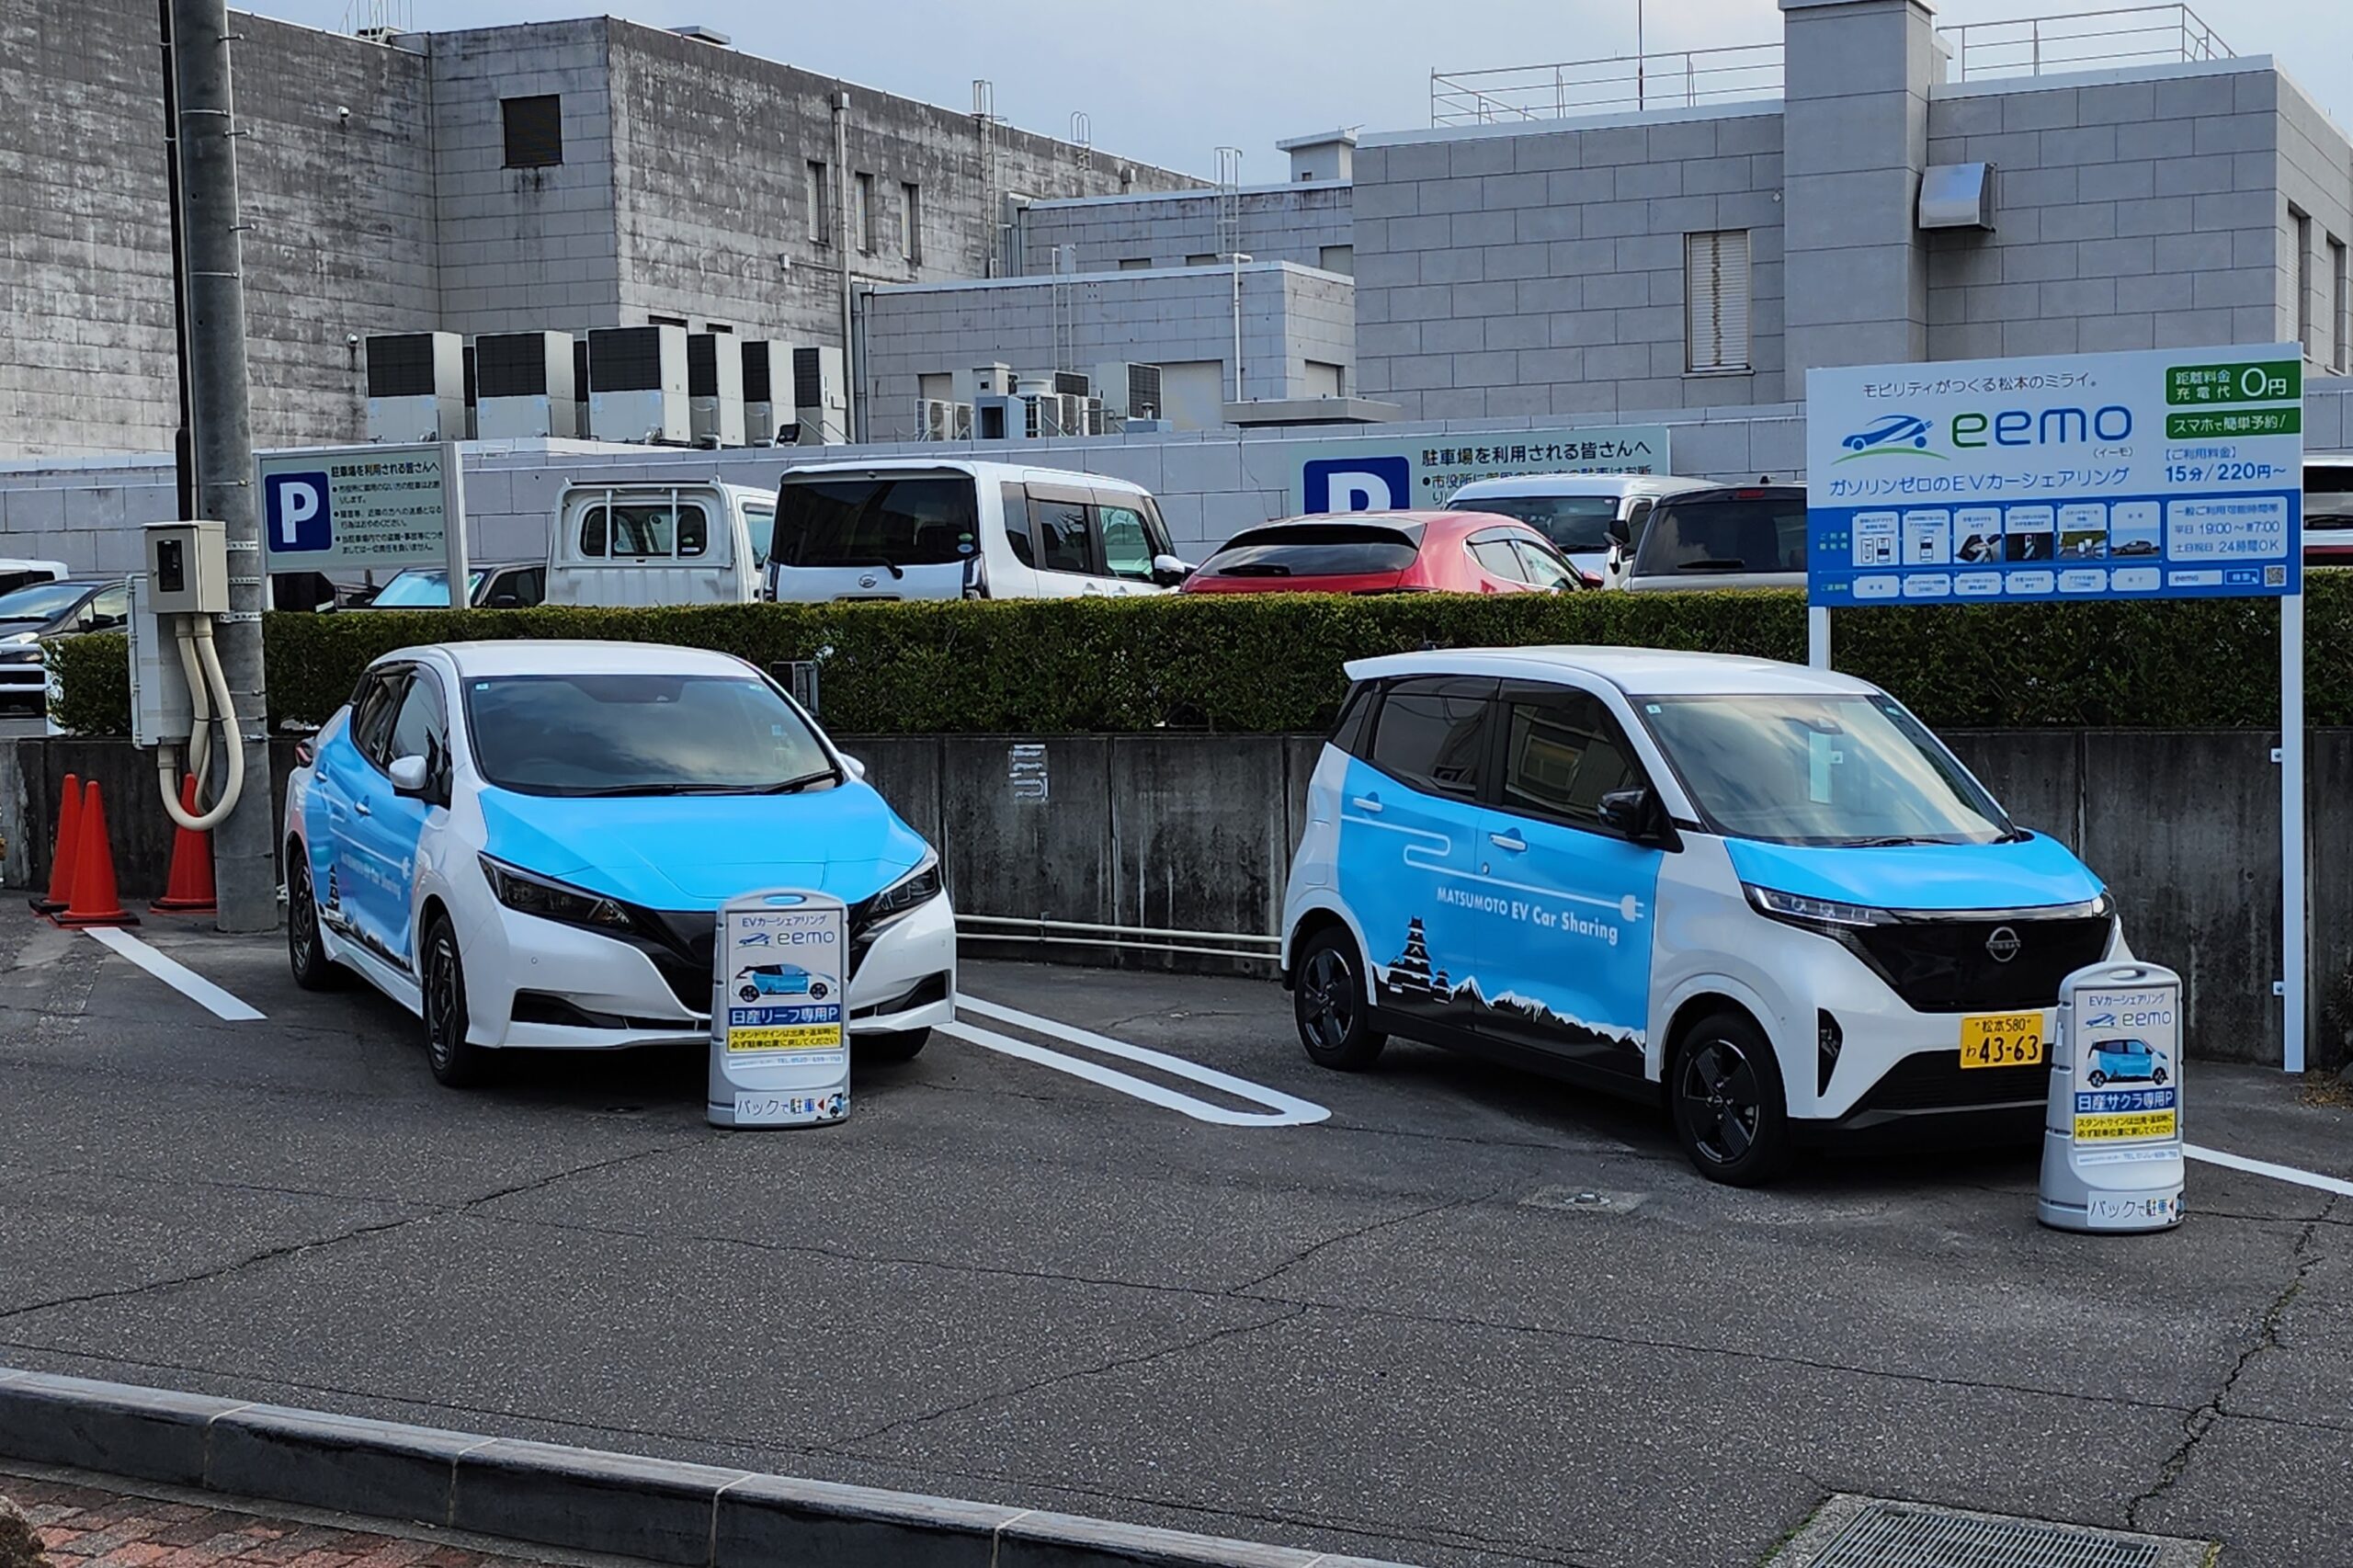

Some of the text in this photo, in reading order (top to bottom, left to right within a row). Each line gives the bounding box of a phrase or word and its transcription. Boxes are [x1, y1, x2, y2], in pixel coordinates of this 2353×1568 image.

[1863, 371, 2097, 398] モビリティがつくる松本のミライ。
[2175, 369, 2231, 385] 距離料金
[1951, 406, 2132, 448] eemo
[1422, 440, 1652, 467] 駐車場を利用される皆さんへ
[332, 461, 439, 477] 駐車場を利用される皆さんへ
[1830, 467, 2129, 496] ガソリンゼロのEVカーシェアリング
[279, 482, 319, 544] P
[742, 915, 827, 928] EVカーシェアリング
[1437, 887, 1619, 946] MATSUMOTO EV Car Sharing
[778, 930, 835, 945] eemo
[1986, 940, 2020, 949] NISSAN
[2089, 993, 2165, 1007] EVカーシェアリング
[732, 1007, 837, 1025] 日産リーフ専用P
[2122, 1010, 2172, 1027] eemo
[1980, 1035, 2038, 1063] 43-63
[737, 1098, 815, 1116] バックで駐車
[2078, 1091, 2173, 1111] 日産サクラ専用P
[2090, 1199, 2167, 1219] バックで駐車
